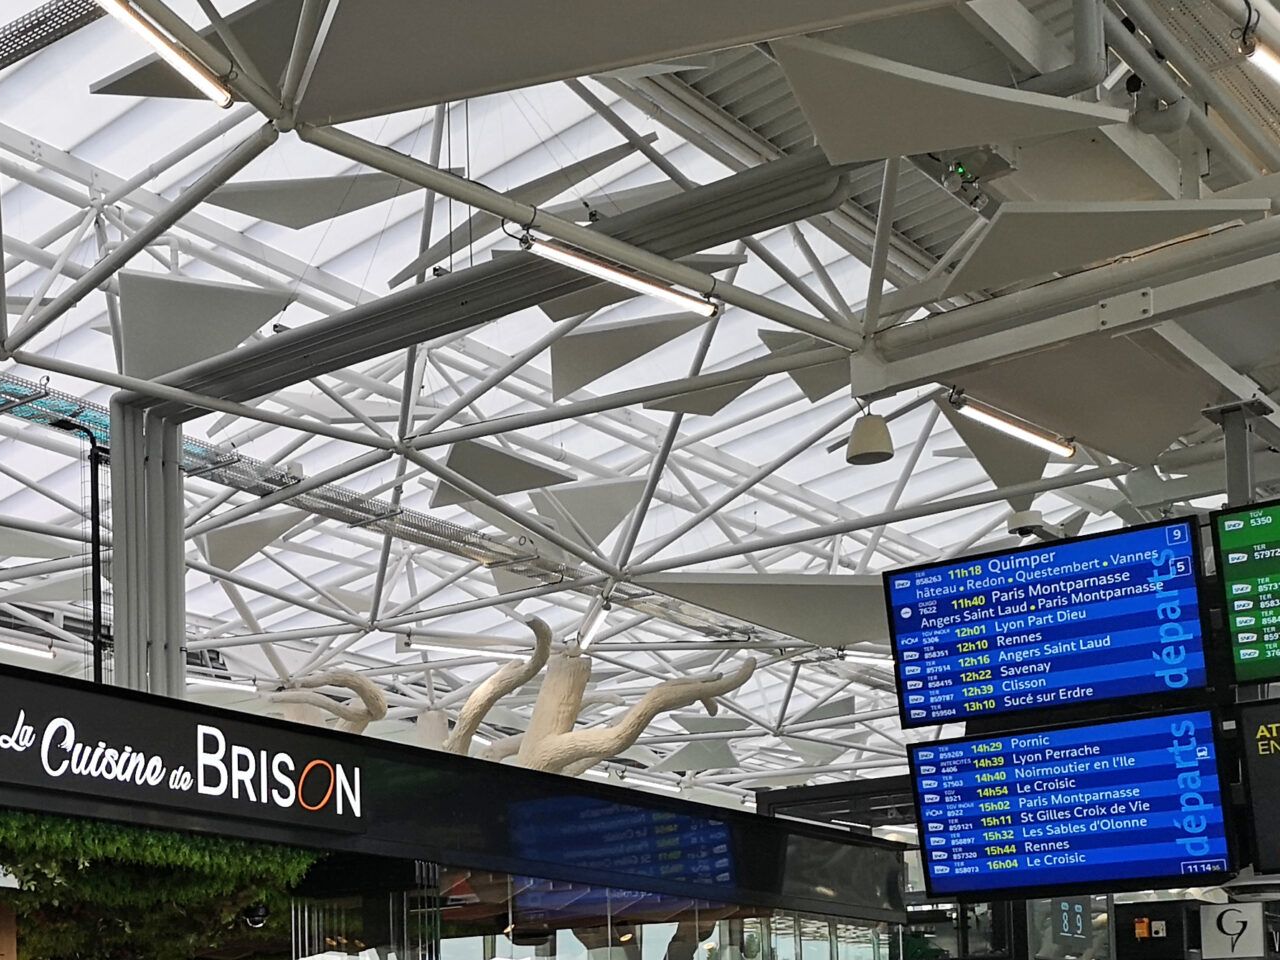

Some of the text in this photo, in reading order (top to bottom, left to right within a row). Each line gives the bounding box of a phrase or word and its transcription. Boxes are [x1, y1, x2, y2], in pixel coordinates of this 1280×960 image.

[1250, 516, 1272, 527] 5350
[1172, 529, 1182, 540] 9
[916, 549, 1159, 600] hâteau Redon Questembert Vannes
[948, 550, 1056, 580] 11h18 Quimper
[1176, 562, 1186, 572] 5
[951, 570, 1130, 611] 11h40 Paris Montparnasse
[918, 606, 938, 616] 7622
[921, 580, 1164, 629] Angers Saint Laud Paris Montparnasse
[954, 608, 1086, 638] 12h01 Lyon Part Dieu
[1147, 549, 1194, 688] départs
[1263, 626, 1276, 634] TER
[922, 636, 940, 645] 5306
[956, 632, 1042, 652] 12h10 Rennes
[958, 636, 1111, 668] 12h16 Angers Saint Laud
[960, 660, 1051, 682] 12h22 Savenay
[962, 678, 1047, 698] 12h39 Clisson
[963, 686, 1094, 712] 13h10 Sucé sur Erdre
[970, 735, 1050, 754] 14h29 Pornic
[40, 716, 166, 788] Cuisine
[168, 764, 194, 792] de
[196, 724, 362, 818] BRISON
[973, 745, 1100, 769] 14h39 Lyon Perrache
[974, 771, 1006, 784] 14h40
[1014, 758, 1094, 779] Noirmoutier
[1094, 760, 1109, 770] en
[976, 778, 1076, 798] 14h54 Le Croisic
[978, 787, 1140, 812] 15h02 Paris Montparnasse
[1168, 720, 1214, 856] départs
[980, 800, 1150, 827] 15h11 St Gilles Croix de Vie
[982, 818, 1148, 842] 15h32 Les Sables d'Olonne
[984, 840, 1070, 856] 15h44 Rennes
[986, 852, 1086, 871] 16h04 Le Croisic
[1062, 912, 1083, 934] 8 9
